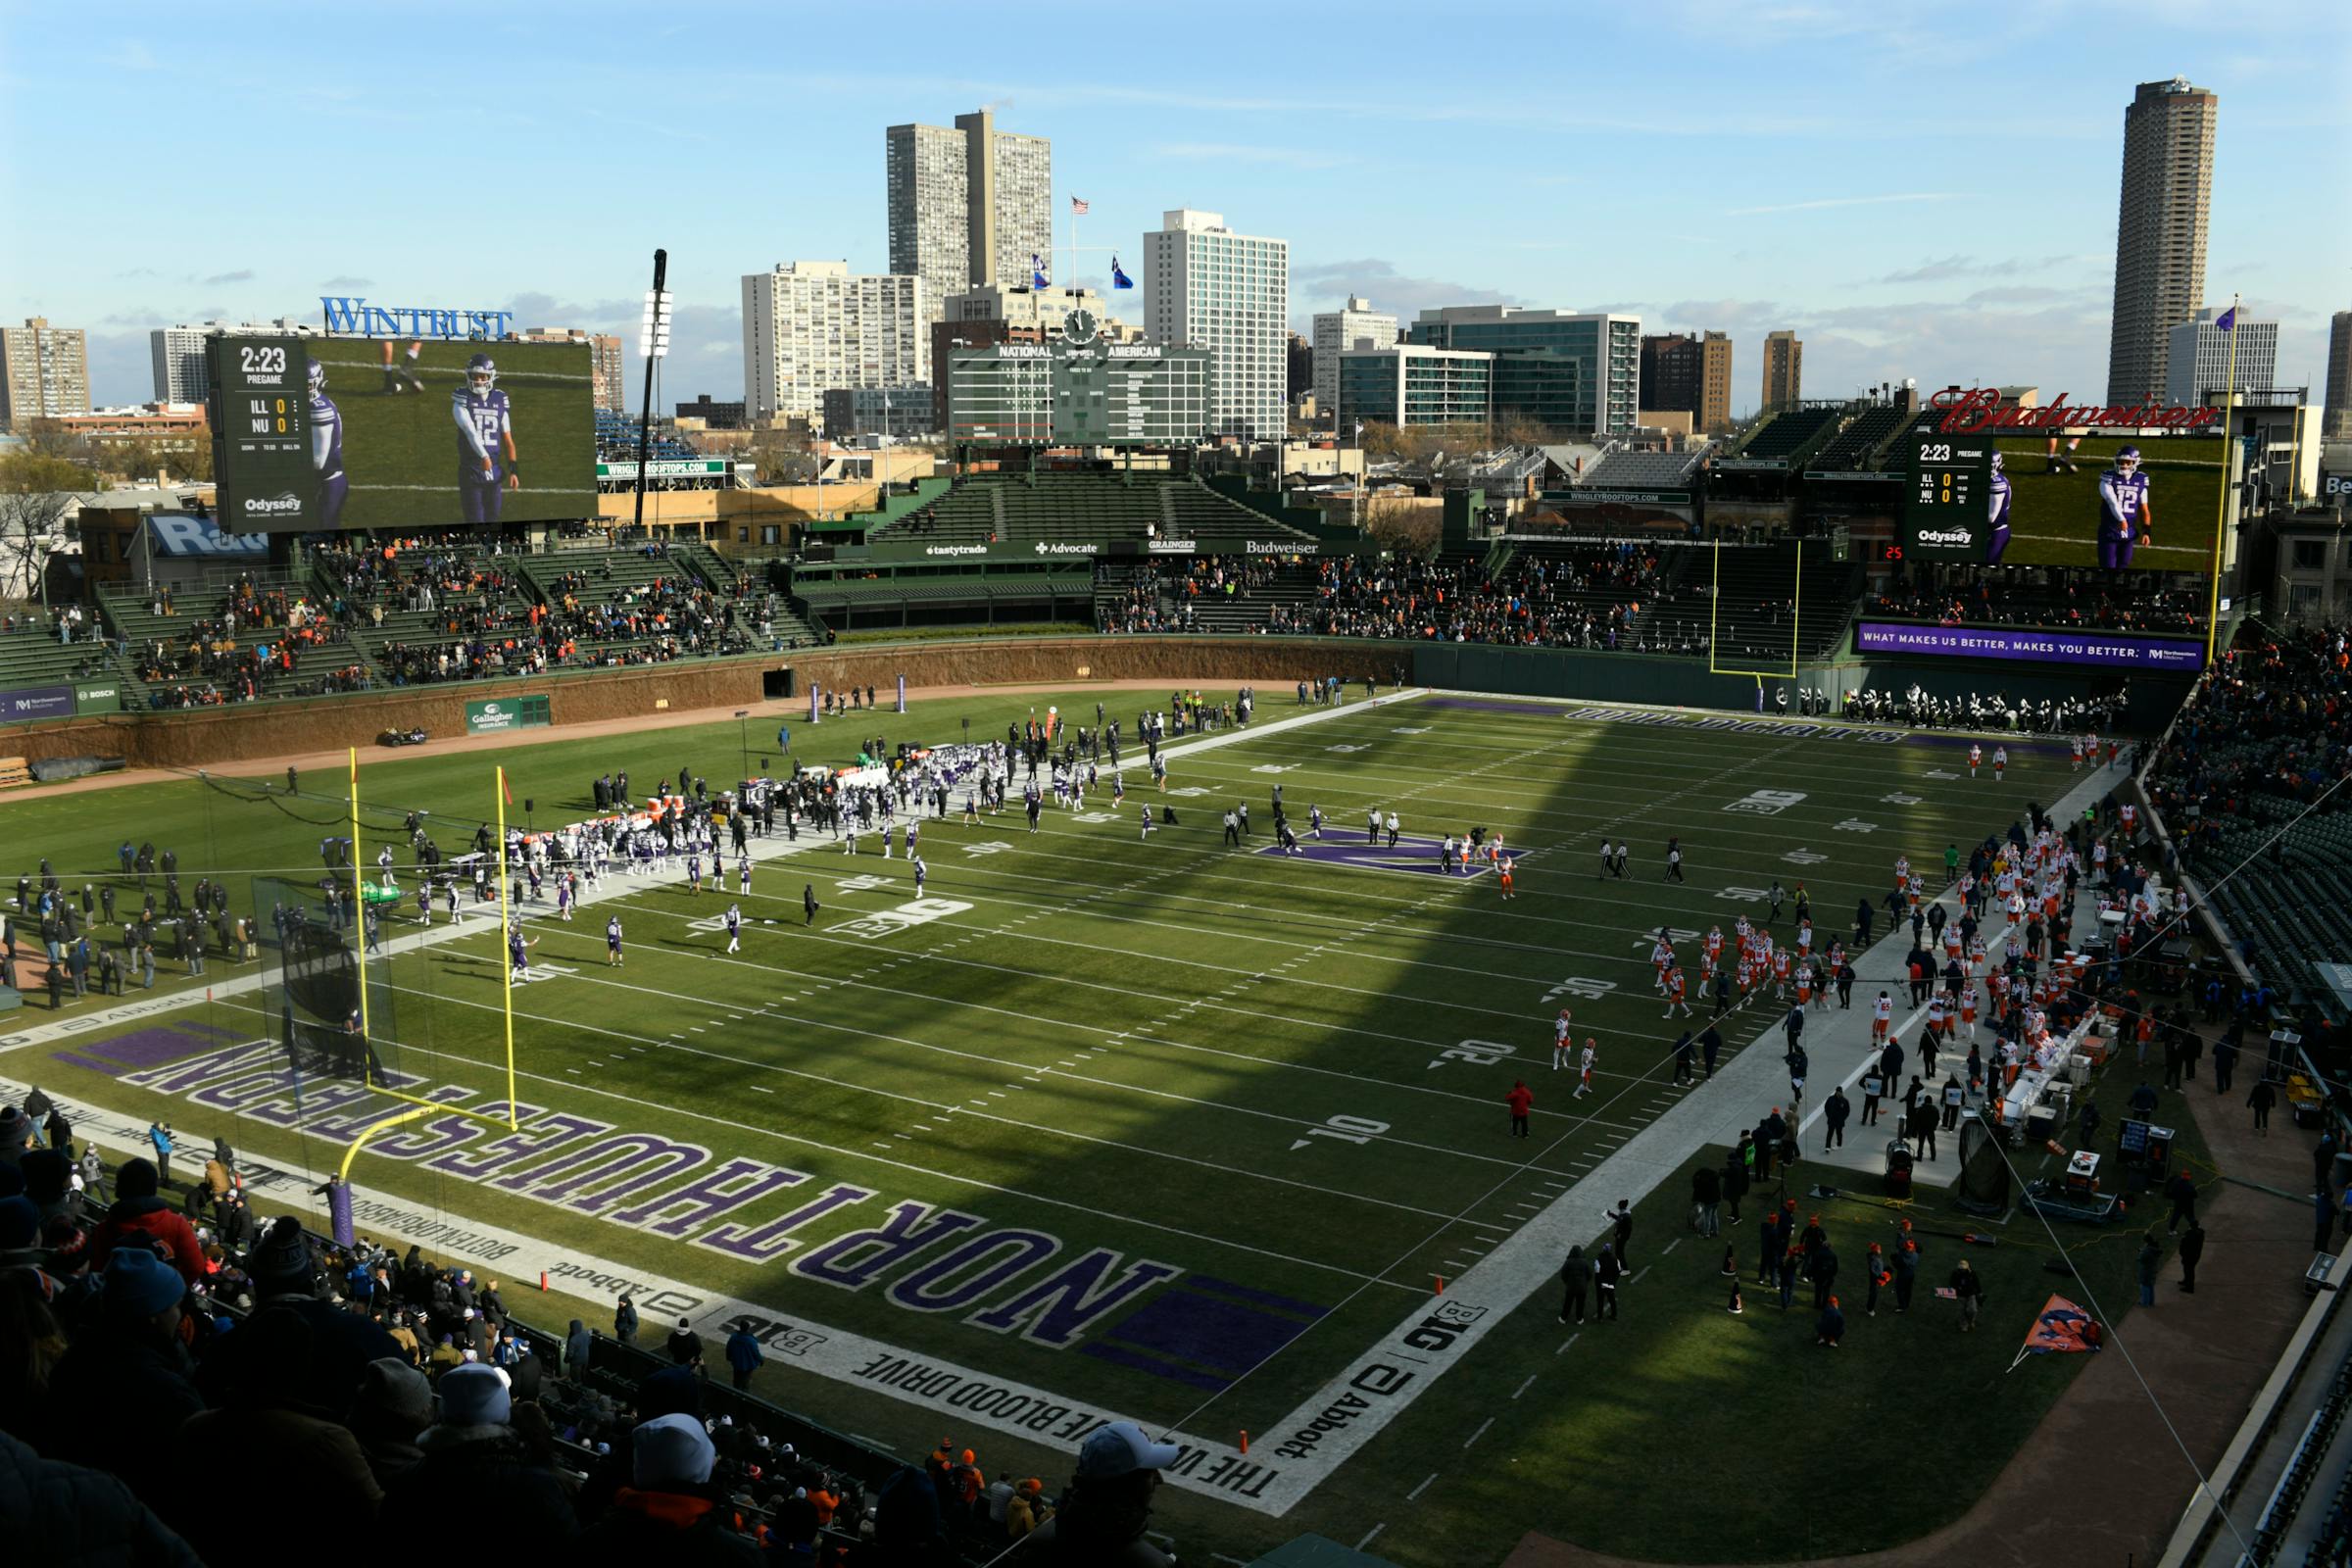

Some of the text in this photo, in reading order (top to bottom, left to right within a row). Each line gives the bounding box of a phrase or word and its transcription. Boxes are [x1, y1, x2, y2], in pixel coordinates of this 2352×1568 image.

[240, 346, 286, 372] 2:23
[1000, 346, 1053, 357] NATIONAL
[1107, 346, 1160, 357] AMERICAN
[247, 374, 282, 384] PREGAME
[251, 399, 285, 414] ILL 0
[1931, 387, 2221, 433] Budweiser
[252, 417, 286, 432] NU 0
[1920, 444, 1950, 462] 2:23
[608, 462, 707, 475] WRIGLEROOFTOPS.COM
[1943, 473, 1950, 486] 0
[1571, 492, 1658, 502] WRIGLEYROOFTOPS.COM
[1922, 489, 1950, 503] NU 0
[245, 498, 301, 512] Odyssey
[1918, 530, 1972, 543] Odyssey
[934, 545, 987, 556] tastytrade
[1050, 544, 1098, 553] Advocate
[1247, 541, 1318, 554] Budweiser
[1886, 547, 1902, 559] 25
[1863, 632, 1894, 643] WHAT
[1898, 634, 1937, 646] MAKES
[1941, 636, 1957, 646] US
[1961, 638, 2009, 651] BETTER,
[2013, 641, 2054, 653] MAKES
[2059, 644, 2083, 655] YOU
[89, 689, 115, 699] BOSCH
[472, 712, 514, 723] Gallagher
[1565, 707, 1910, 745] WILDCATS
[835, 874, 897, 890] 30
[1714, 886, 1768, 902] 50
[1548, 977, 1618, 1000] 30
[108, 995, 195, 1021] Abbott
[1441, 1039, 1516, 1065] 20
[1308, 1114, 1391, 1145] 10
[549, 1261, 655, 1298] Abbott
[852, 1352, 962, 1399] DRIVE
[949, 1383, 1070, 1434] BLOOD
[1274, 1392, 1370, 1459] Abbott
[1198, 1455, 1279, 1498] THE
